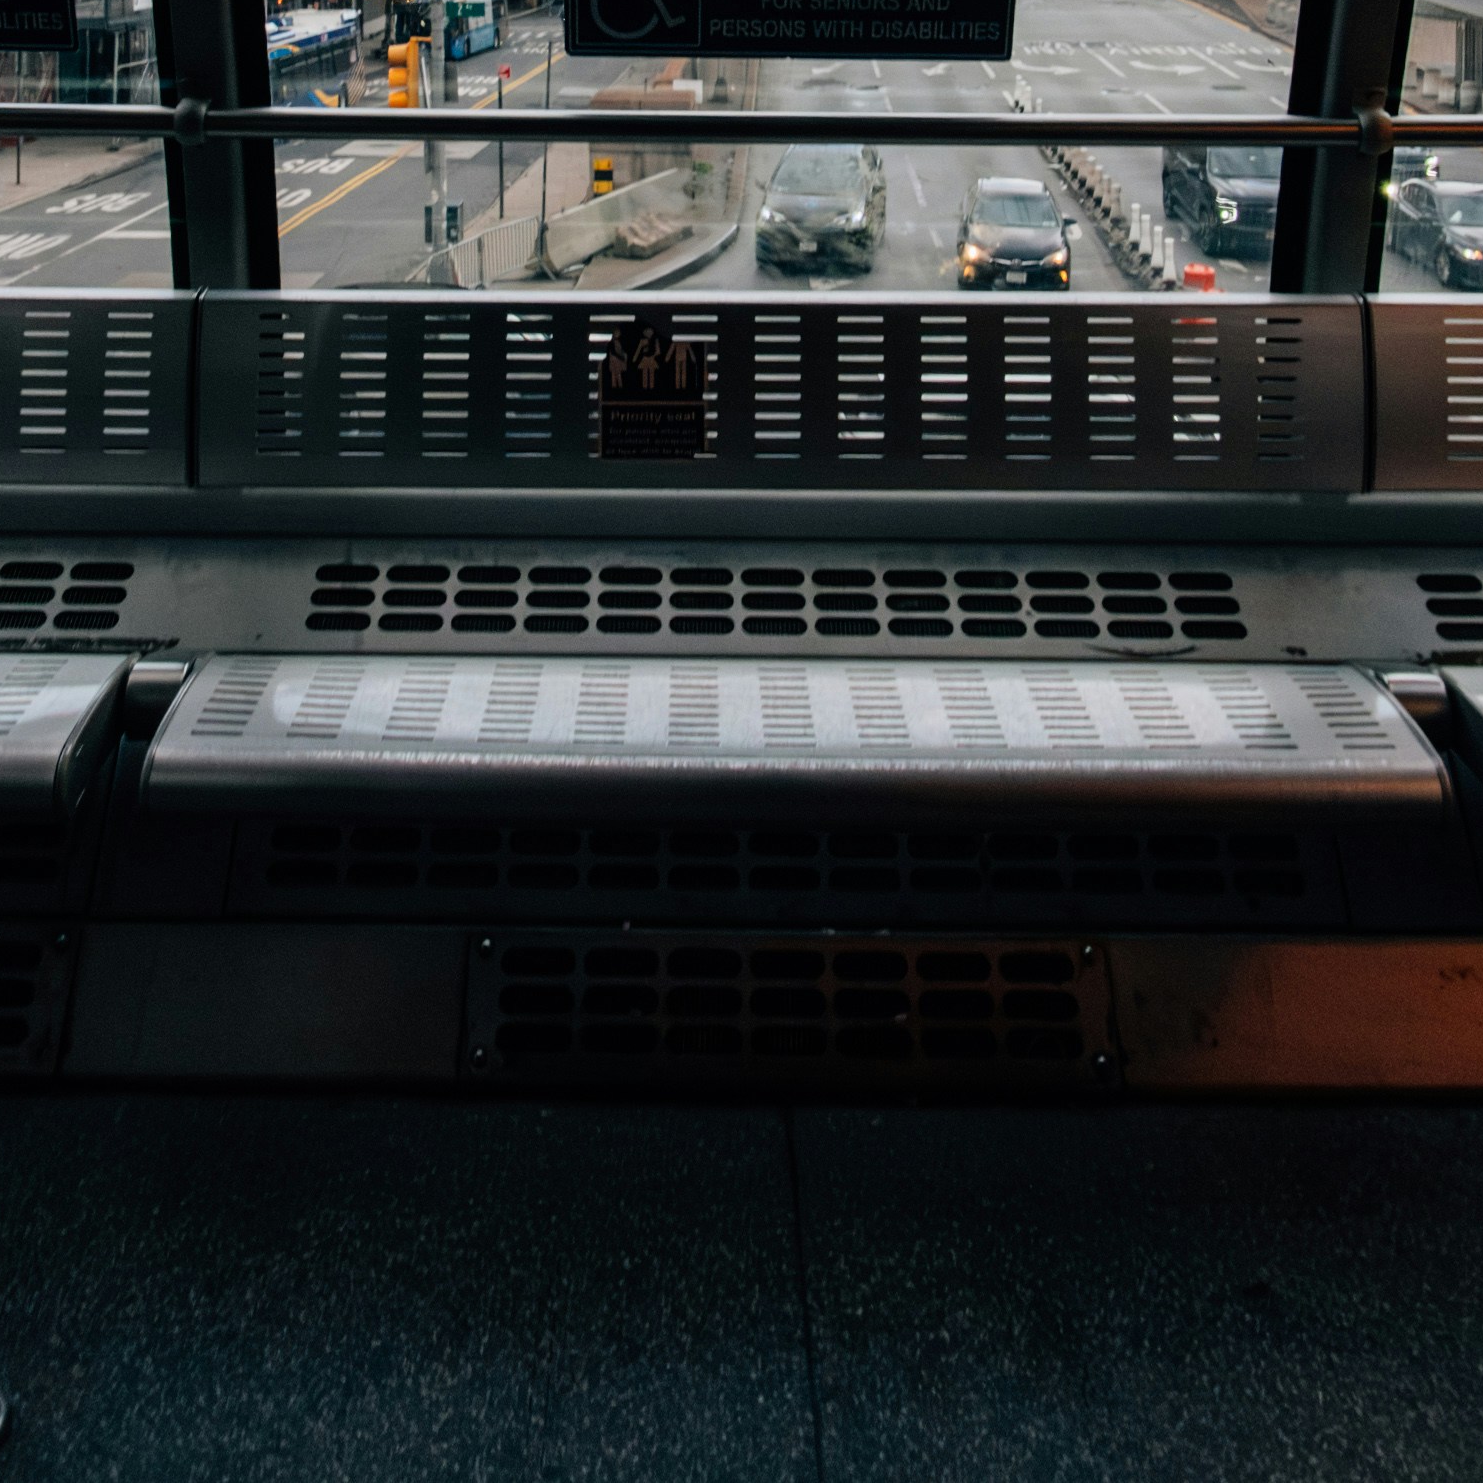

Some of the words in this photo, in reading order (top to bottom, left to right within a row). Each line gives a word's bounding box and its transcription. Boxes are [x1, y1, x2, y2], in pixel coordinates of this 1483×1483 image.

[709, 18, 806, 39] PERSONS
[812, 20, 864, 40] WITH
[870, 20, 1001, 41] DISABILITIES
[45, 192, 151, 214] BUS
